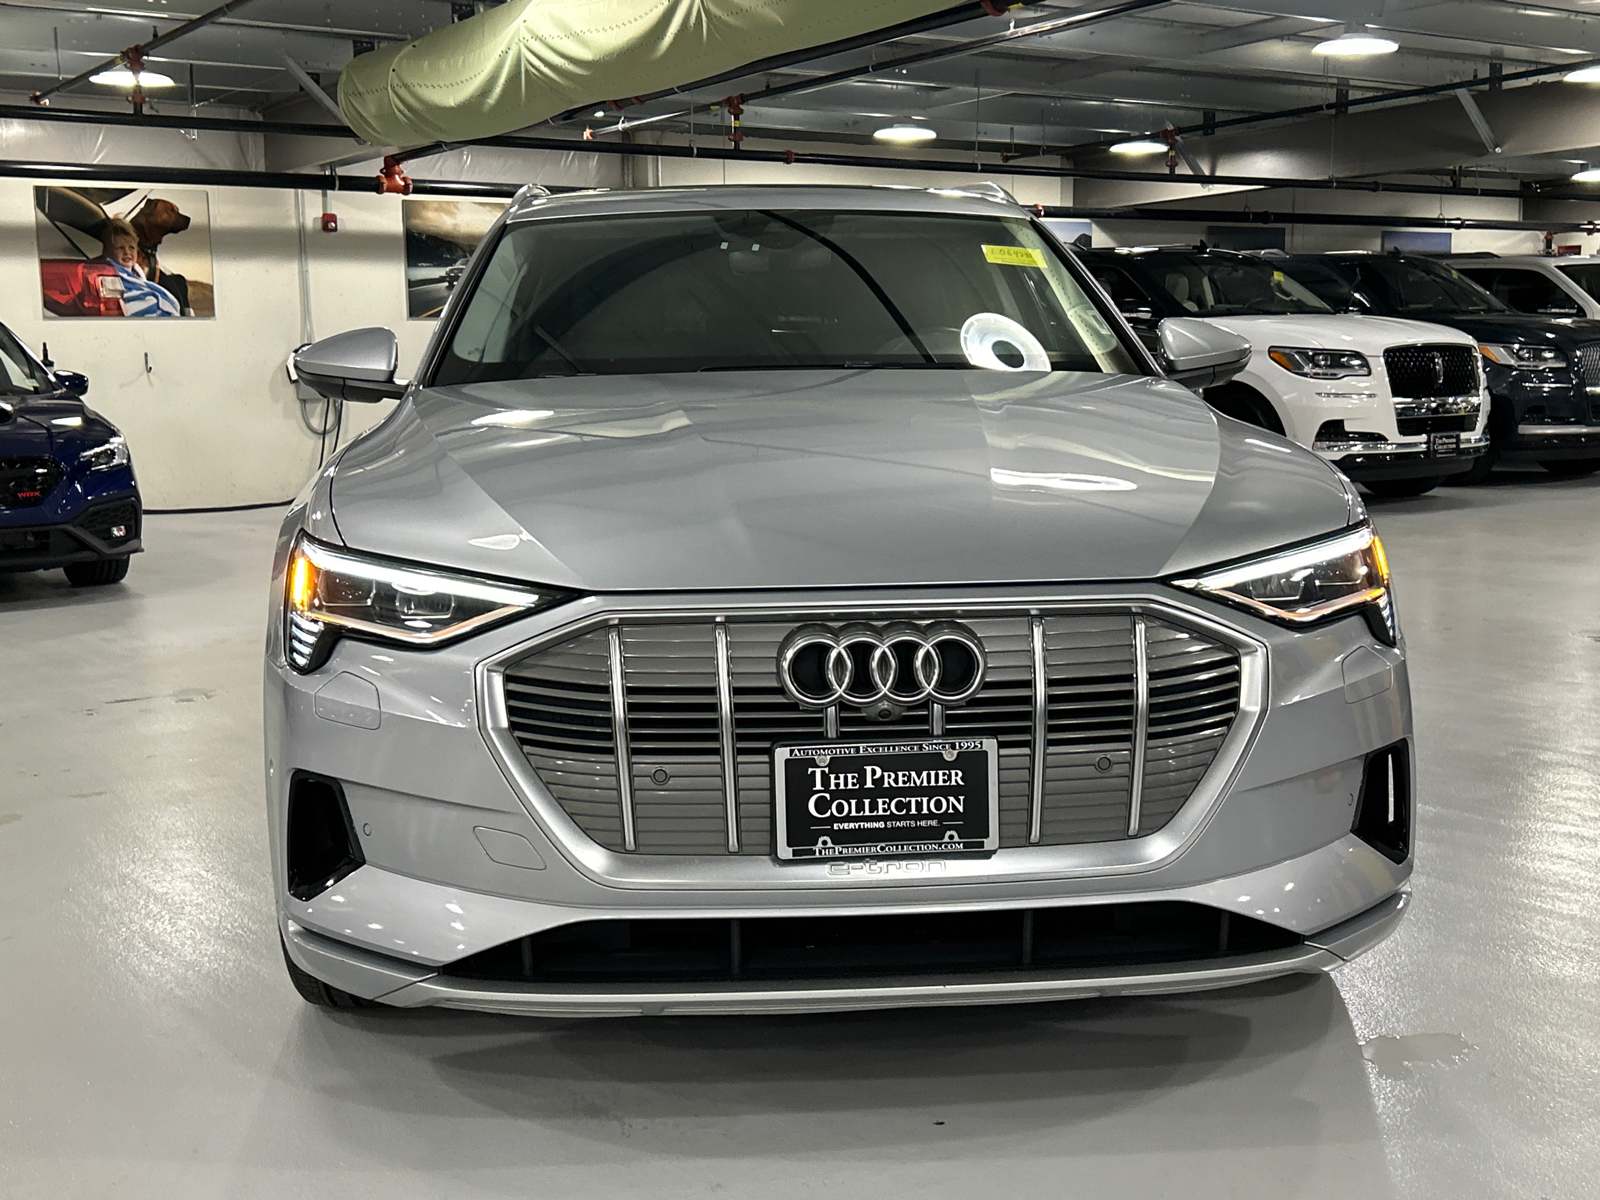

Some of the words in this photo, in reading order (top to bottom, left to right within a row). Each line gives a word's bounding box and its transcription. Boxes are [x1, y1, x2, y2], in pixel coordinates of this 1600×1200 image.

[791, 748, 857, 757] AUTOMOTIVE
[859, 745, 920, 754] EXCELLENCE
[922, 743, 951, 752] SINCE
[954, 741, 982, 750] 1995
[807, 767, 859, 791] THE
[863, 765, 965, 789] PREMIER
[807, 793, 965, 818] COLLECTION
[833, 822, 885, 830] EVERYTHING
[886, 820, 916, 828] STARTS
[917, 819, 940, 827] HERE.
[826, 858, 947, 876] e-tron
